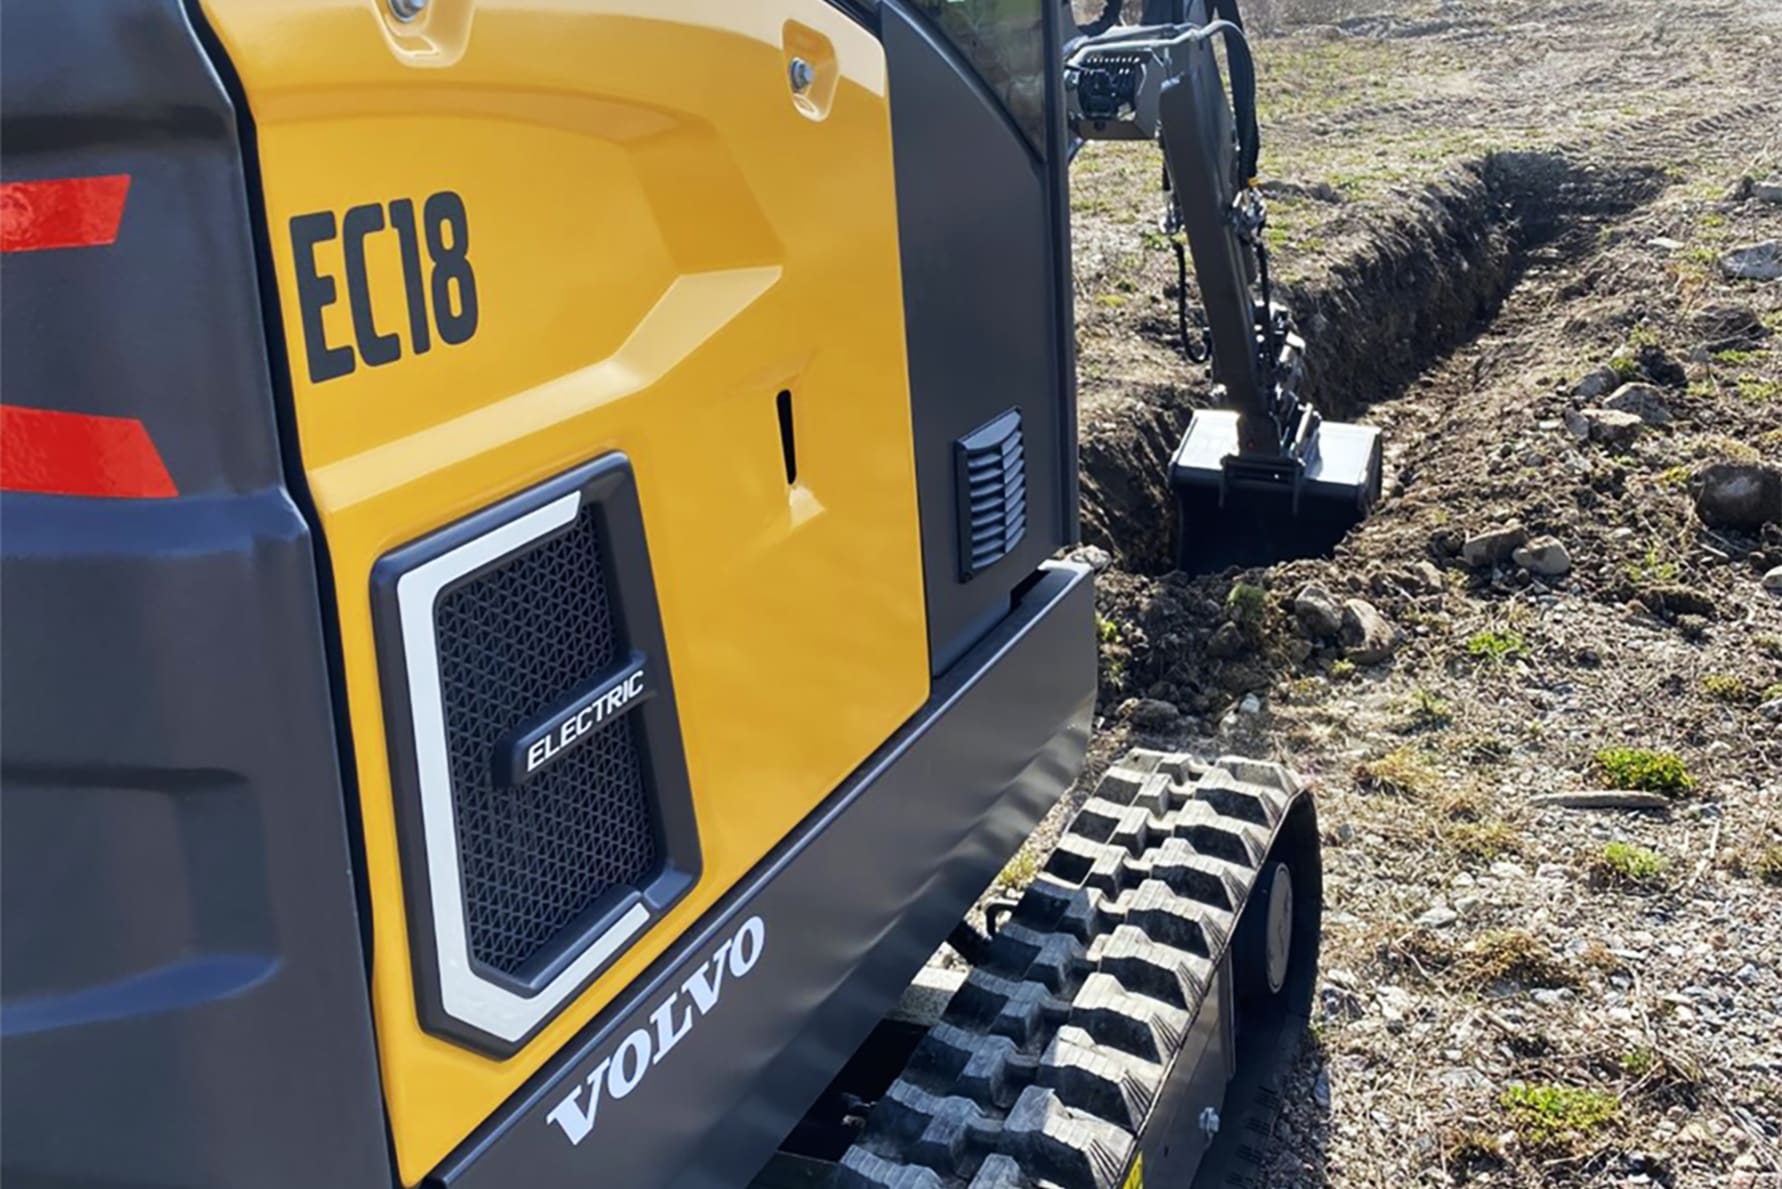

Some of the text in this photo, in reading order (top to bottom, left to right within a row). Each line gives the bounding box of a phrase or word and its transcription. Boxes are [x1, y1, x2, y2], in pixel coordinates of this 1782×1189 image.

[289, 191, 478, 384] EC18
[526, 669, 644, 773] ELECTRIC
[546, 915, 766, 1145] VOLVO
